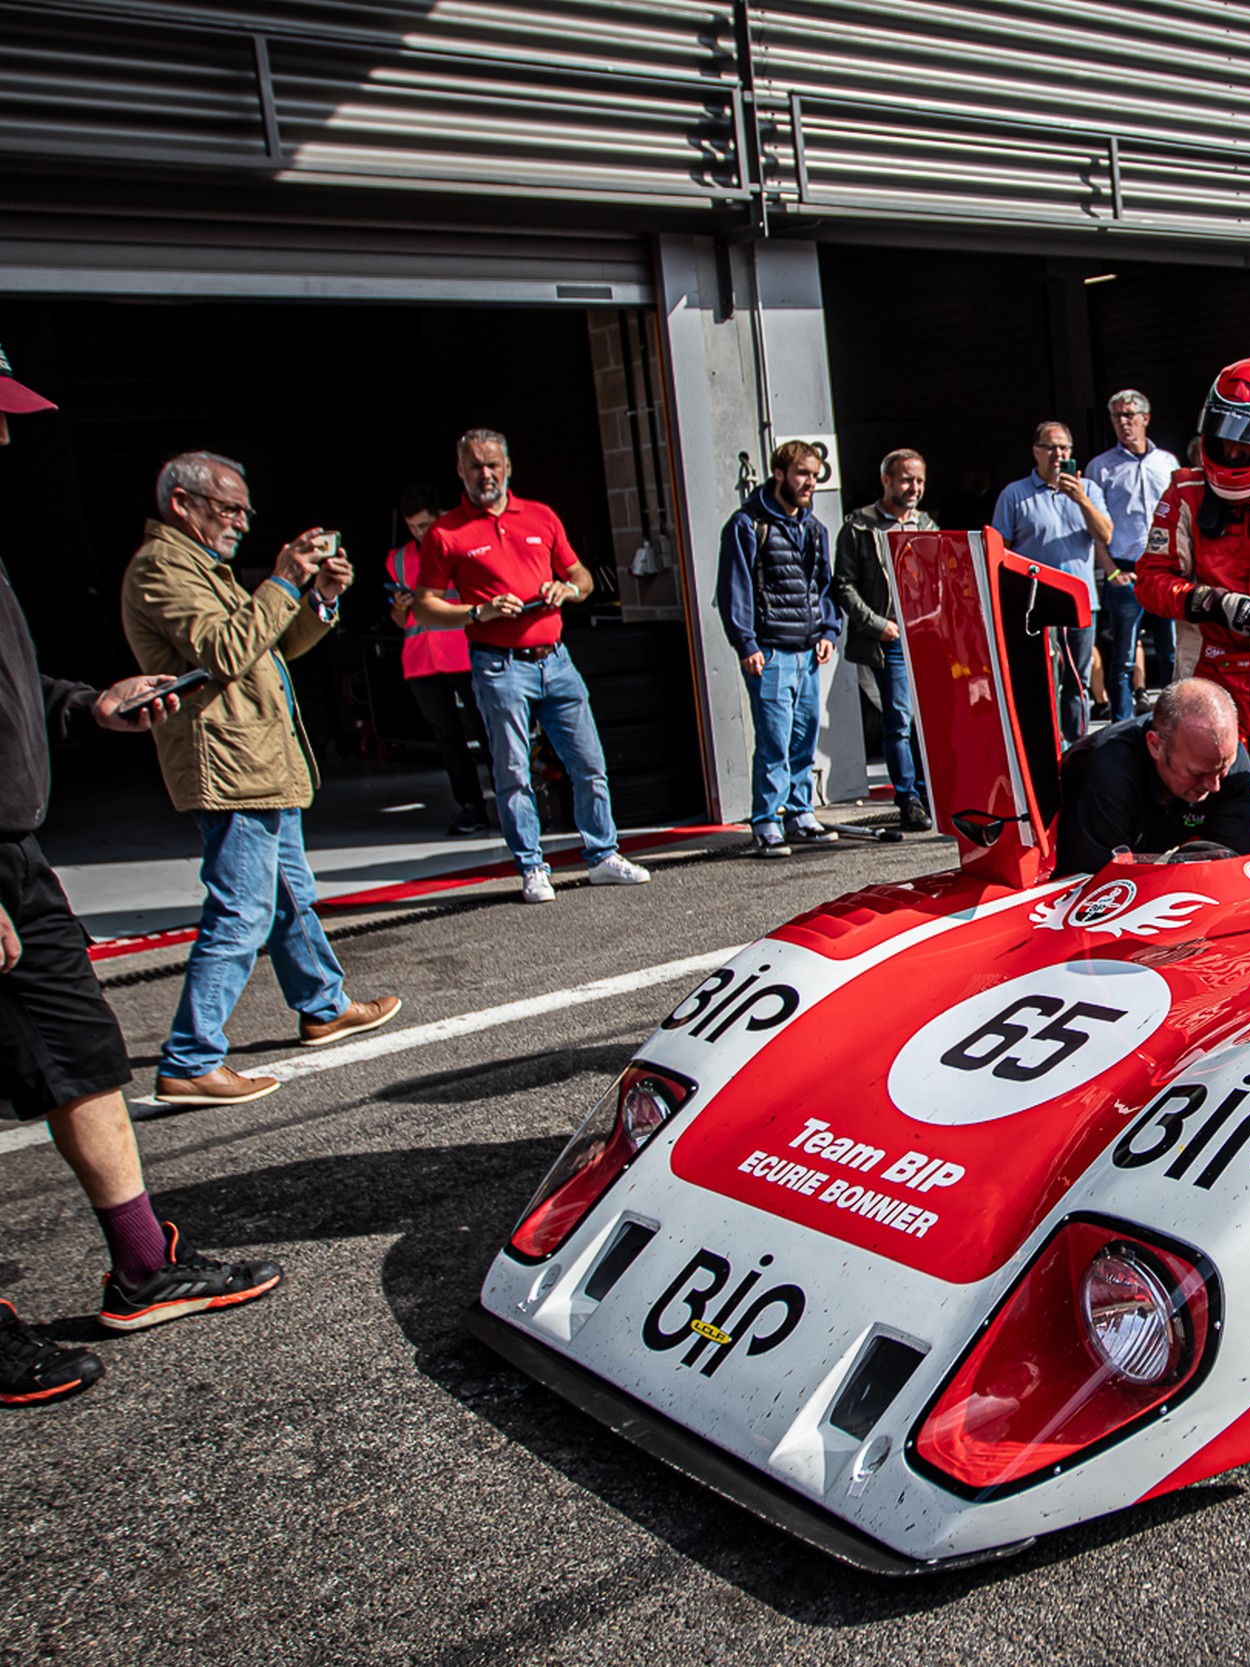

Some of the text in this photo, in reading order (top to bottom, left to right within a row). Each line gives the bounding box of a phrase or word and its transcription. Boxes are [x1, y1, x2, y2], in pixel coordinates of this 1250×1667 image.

[940, 993, 1129, 1082] 65
[737, 1150, 939, 1239] ECURIE BONNIER
[788, 1117, 966, 1193] Team BIP
